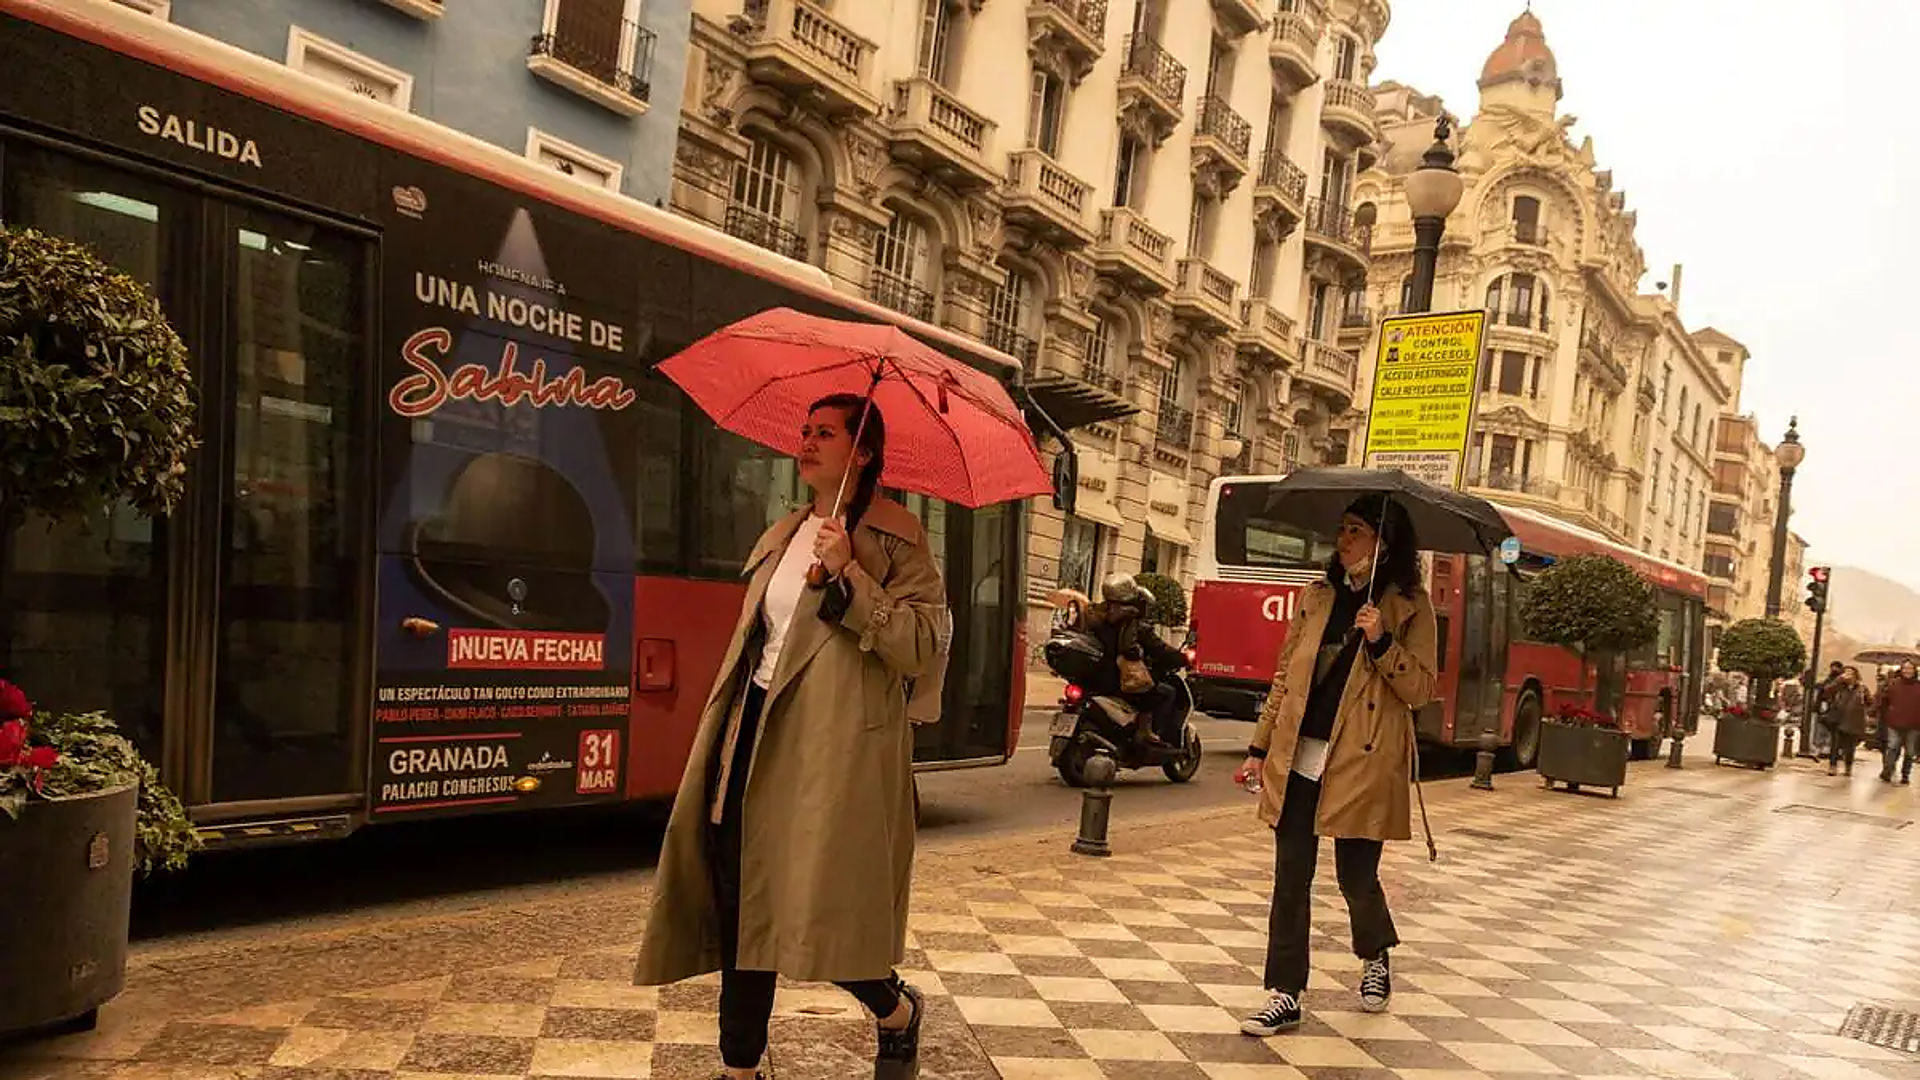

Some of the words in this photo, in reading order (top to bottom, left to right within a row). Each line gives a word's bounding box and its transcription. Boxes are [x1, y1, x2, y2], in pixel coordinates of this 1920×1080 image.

[138, 105, 262, 168] SALIDA
[415, 271, 480, 316] UNA
[487, 291, 583, 342] NOCHE
[590, 319, 624, 352] DE
[1403, 351, 1416, 361] DE
[1419, 349, 1470, 360] ACCESOS
[1413, 338, 1464, 349] CONTROL
[389, 327, 636, 417] Sabina
[451, 636, 529, 662] ¡NUEVA
[533, 638, 603, 662] FECHA!
[379, 687, 395, 701] UN
[397, 684, 471, 701] ESPECTÁCULO
[473, 687, 494, 700] TAN
[495, 686, 526, 700] GOLFO
[527, 686, 554, 699] COMO
[389, 745, 509, 775] GRANADA
[583, 733, 613, 768] 31
[382, 781, 439, 801] PALACIO
[442, 775, 516, 797] CONGRESOS
[579, 769, 616, 789] MAR
